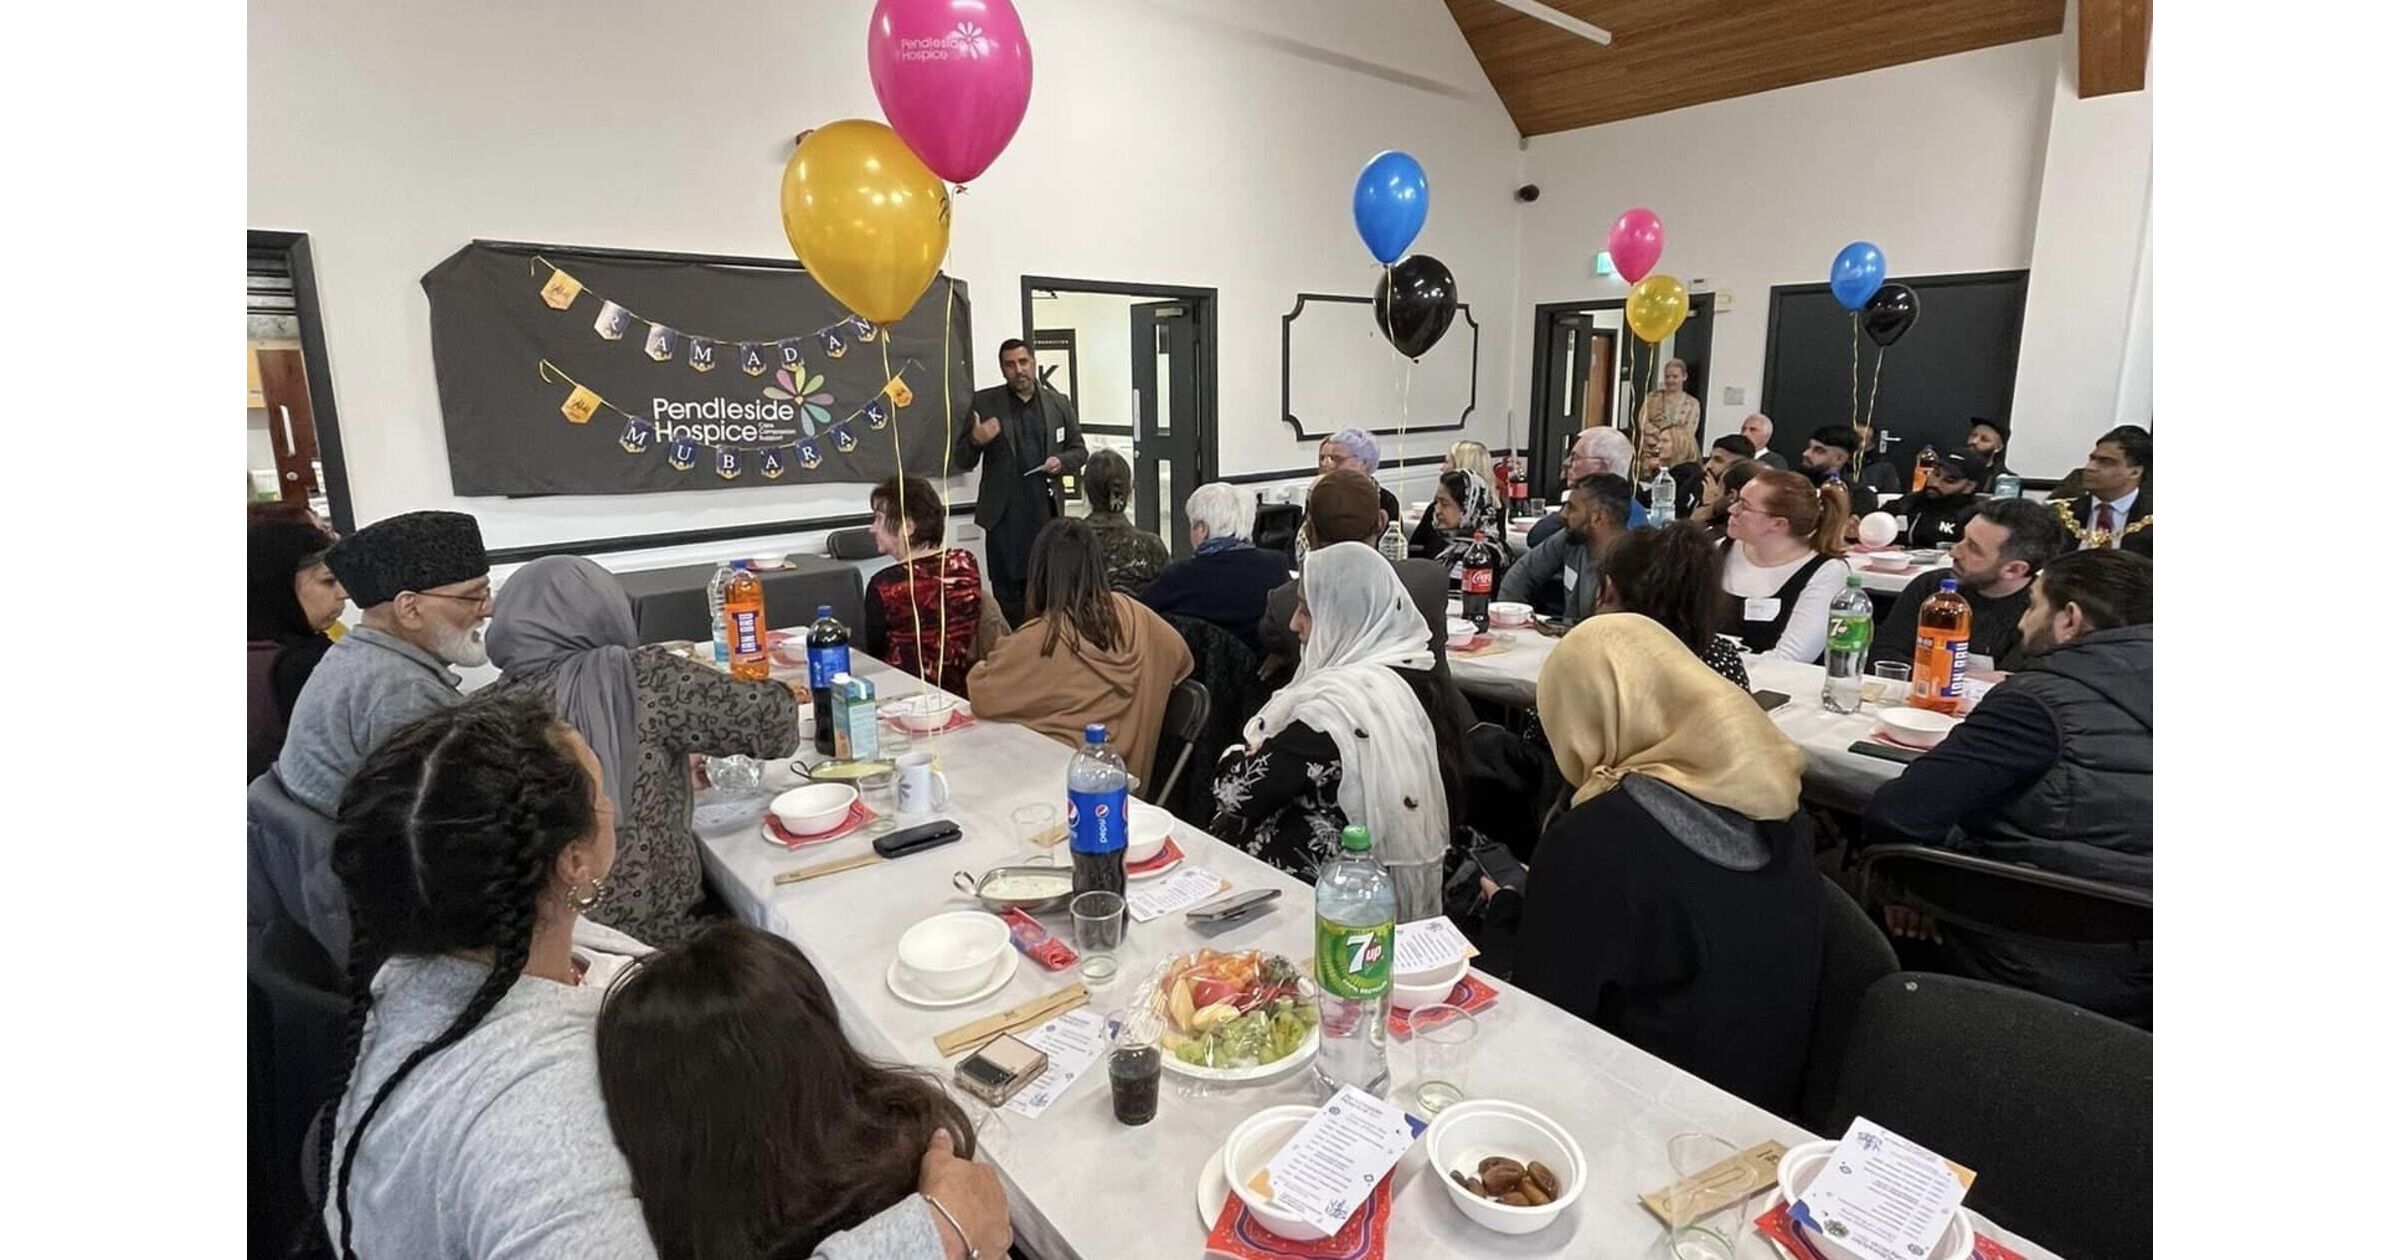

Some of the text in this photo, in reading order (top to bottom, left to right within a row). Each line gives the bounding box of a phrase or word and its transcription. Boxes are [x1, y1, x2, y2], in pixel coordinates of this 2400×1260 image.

[652, 397, 795, 421] Pendleside
[625, 406, 884, 470] MUBARAK
[655, 420, 758, 446] Hospice
[1939, 520, 1956, 535] NK
[1098, 817, 1108, 844] pepsi
